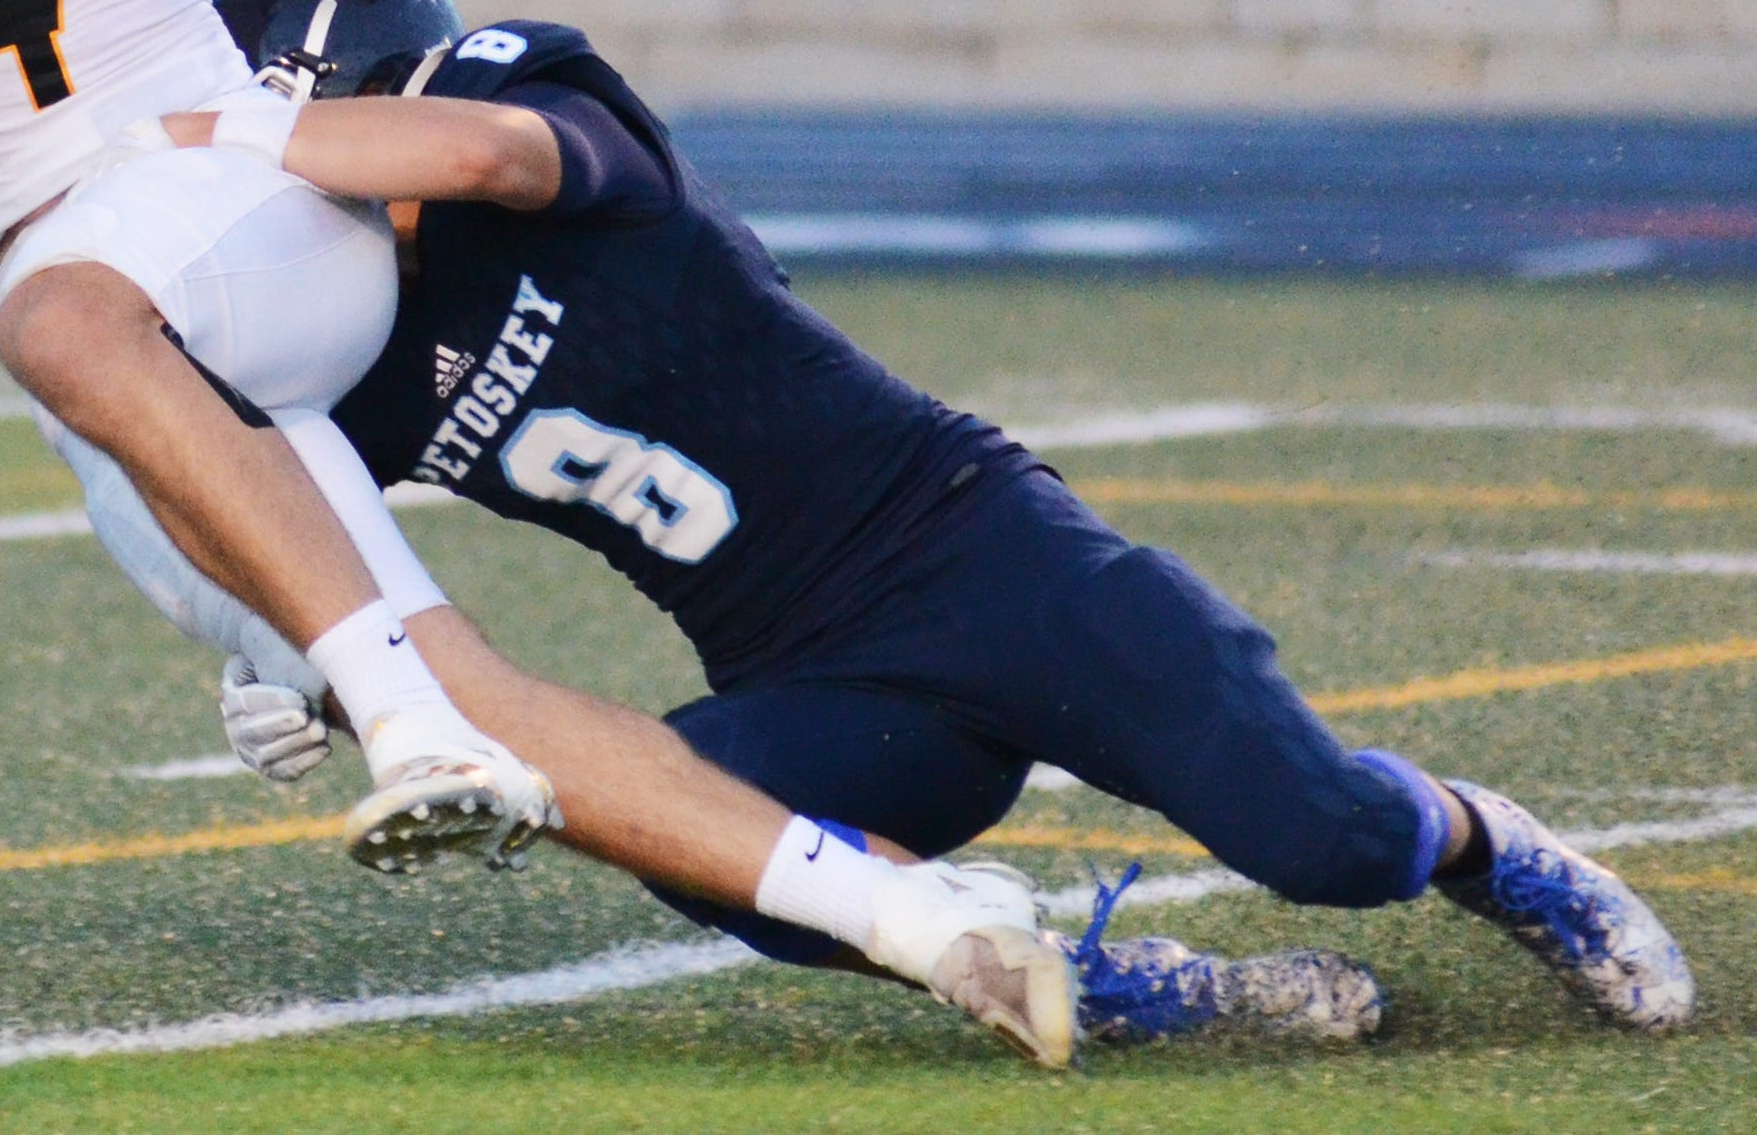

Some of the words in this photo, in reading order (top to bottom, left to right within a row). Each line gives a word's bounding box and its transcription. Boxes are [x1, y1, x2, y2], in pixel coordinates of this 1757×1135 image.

[456, 28, 528, 64] 8
[436, 351, 477, 399] adidas
[499, 406, 740, 565] 8
